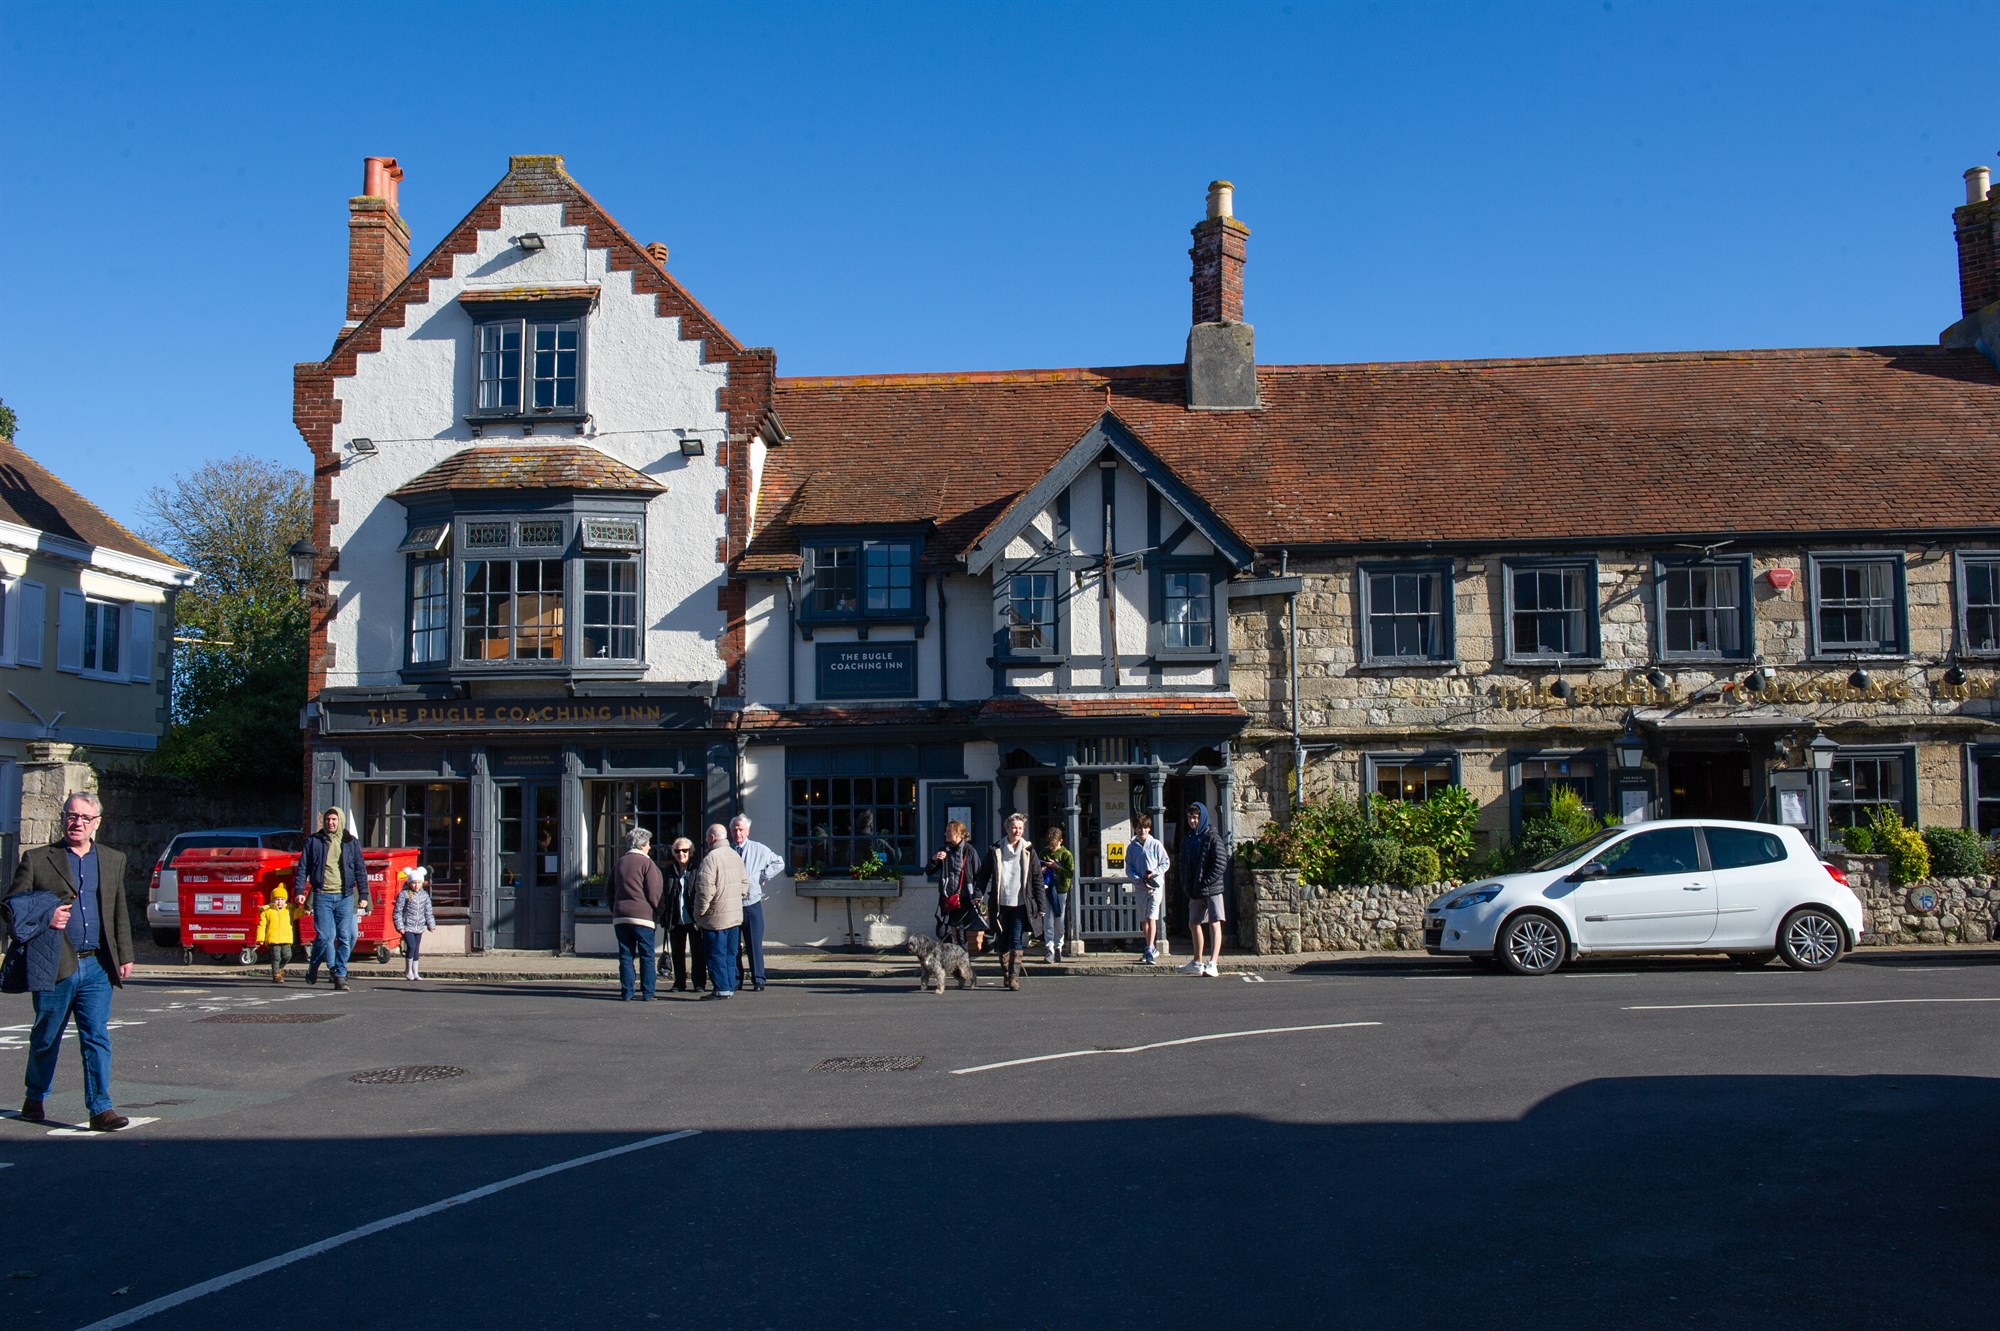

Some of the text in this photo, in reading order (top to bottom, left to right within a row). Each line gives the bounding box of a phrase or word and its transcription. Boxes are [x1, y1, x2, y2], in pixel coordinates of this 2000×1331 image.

[1575, 682, 1684, 705] BUGLE
[1733, 680, 1909, 702] COACHING
[1935, 676, 1996, 699] INN
[368, 706, 661, 723] THE BUGLE COACHING INN
[1105, 802, 1125, 810] BAR
[1110, 847, 1123, 856] AA
[1919, 896, 1934, 909] 15
